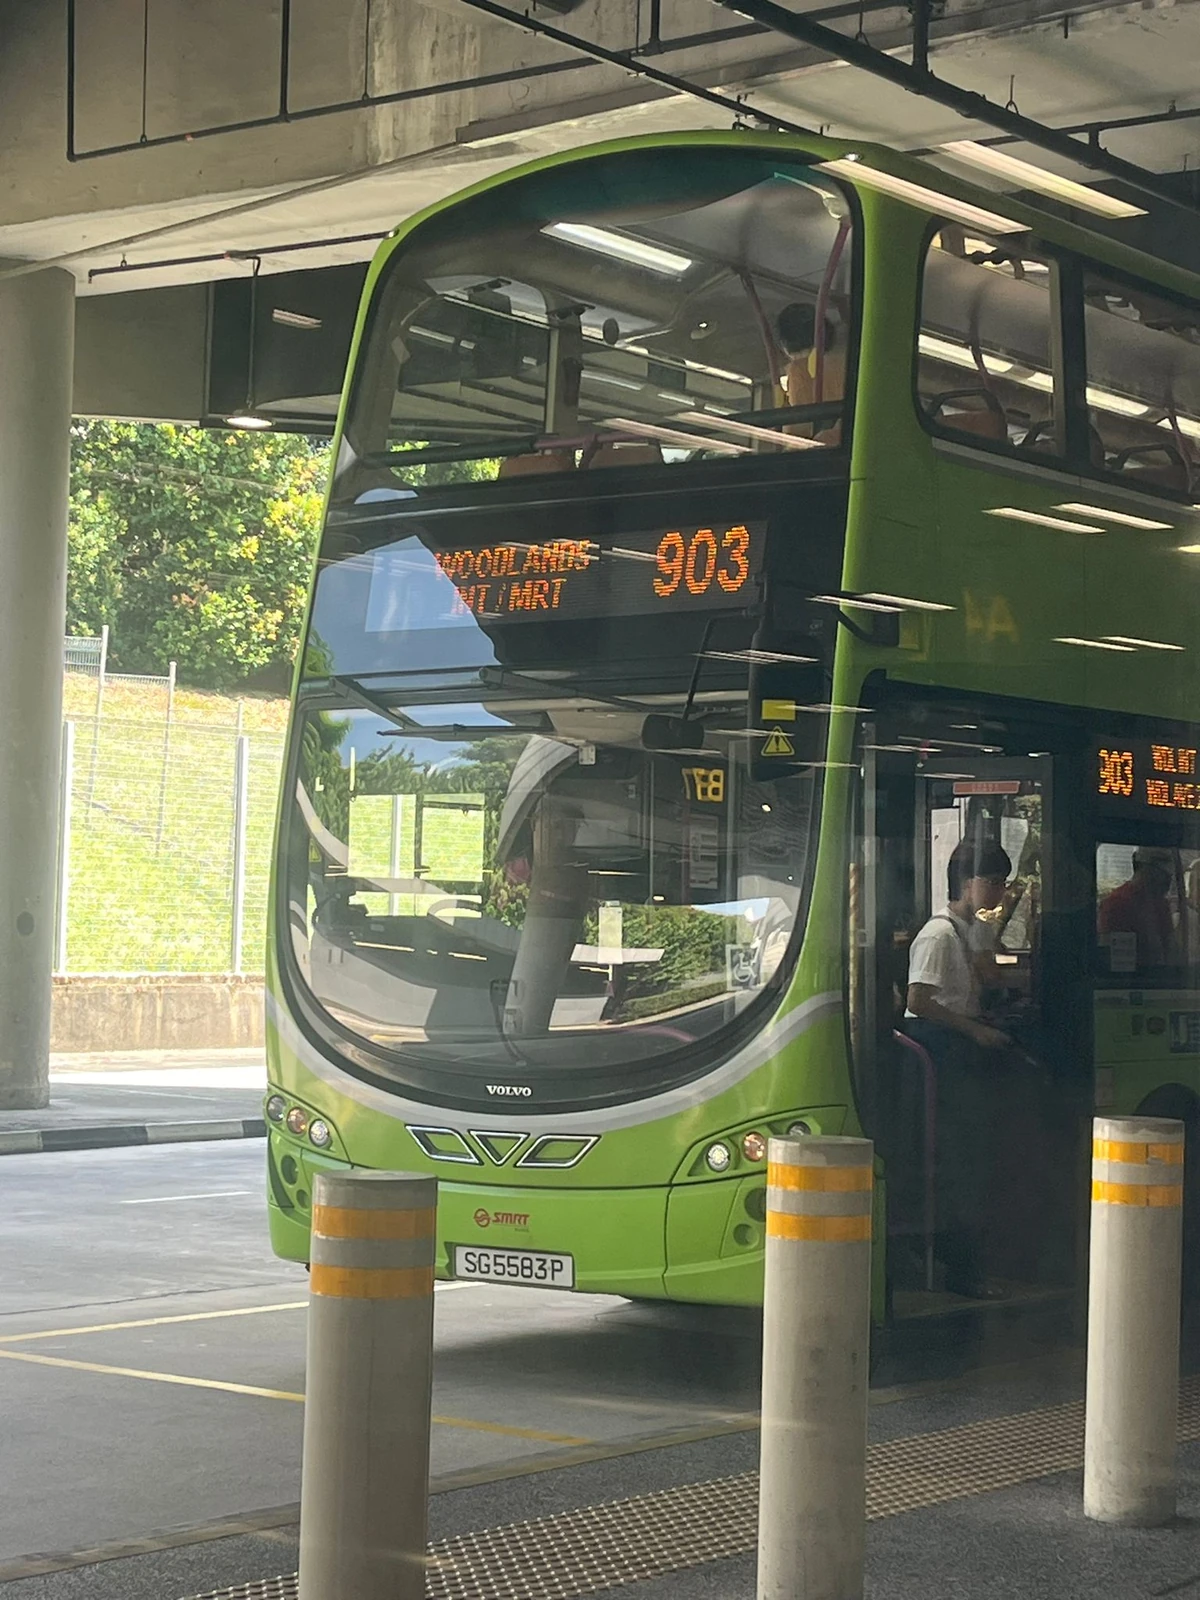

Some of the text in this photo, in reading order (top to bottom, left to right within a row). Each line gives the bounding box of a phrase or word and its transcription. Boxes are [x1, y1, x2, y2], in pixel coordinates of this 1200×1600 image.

[435, 539, 591, 580] WOODLANDS
[652, 525, 750, 597] 903
[1098, 748, 1133, 796] 903
[486, 1085, 532, 1097] VOLVO
[492, 1212, 530, 1225] SMRT
[464, 1251, 564, 1282] SG5583P
